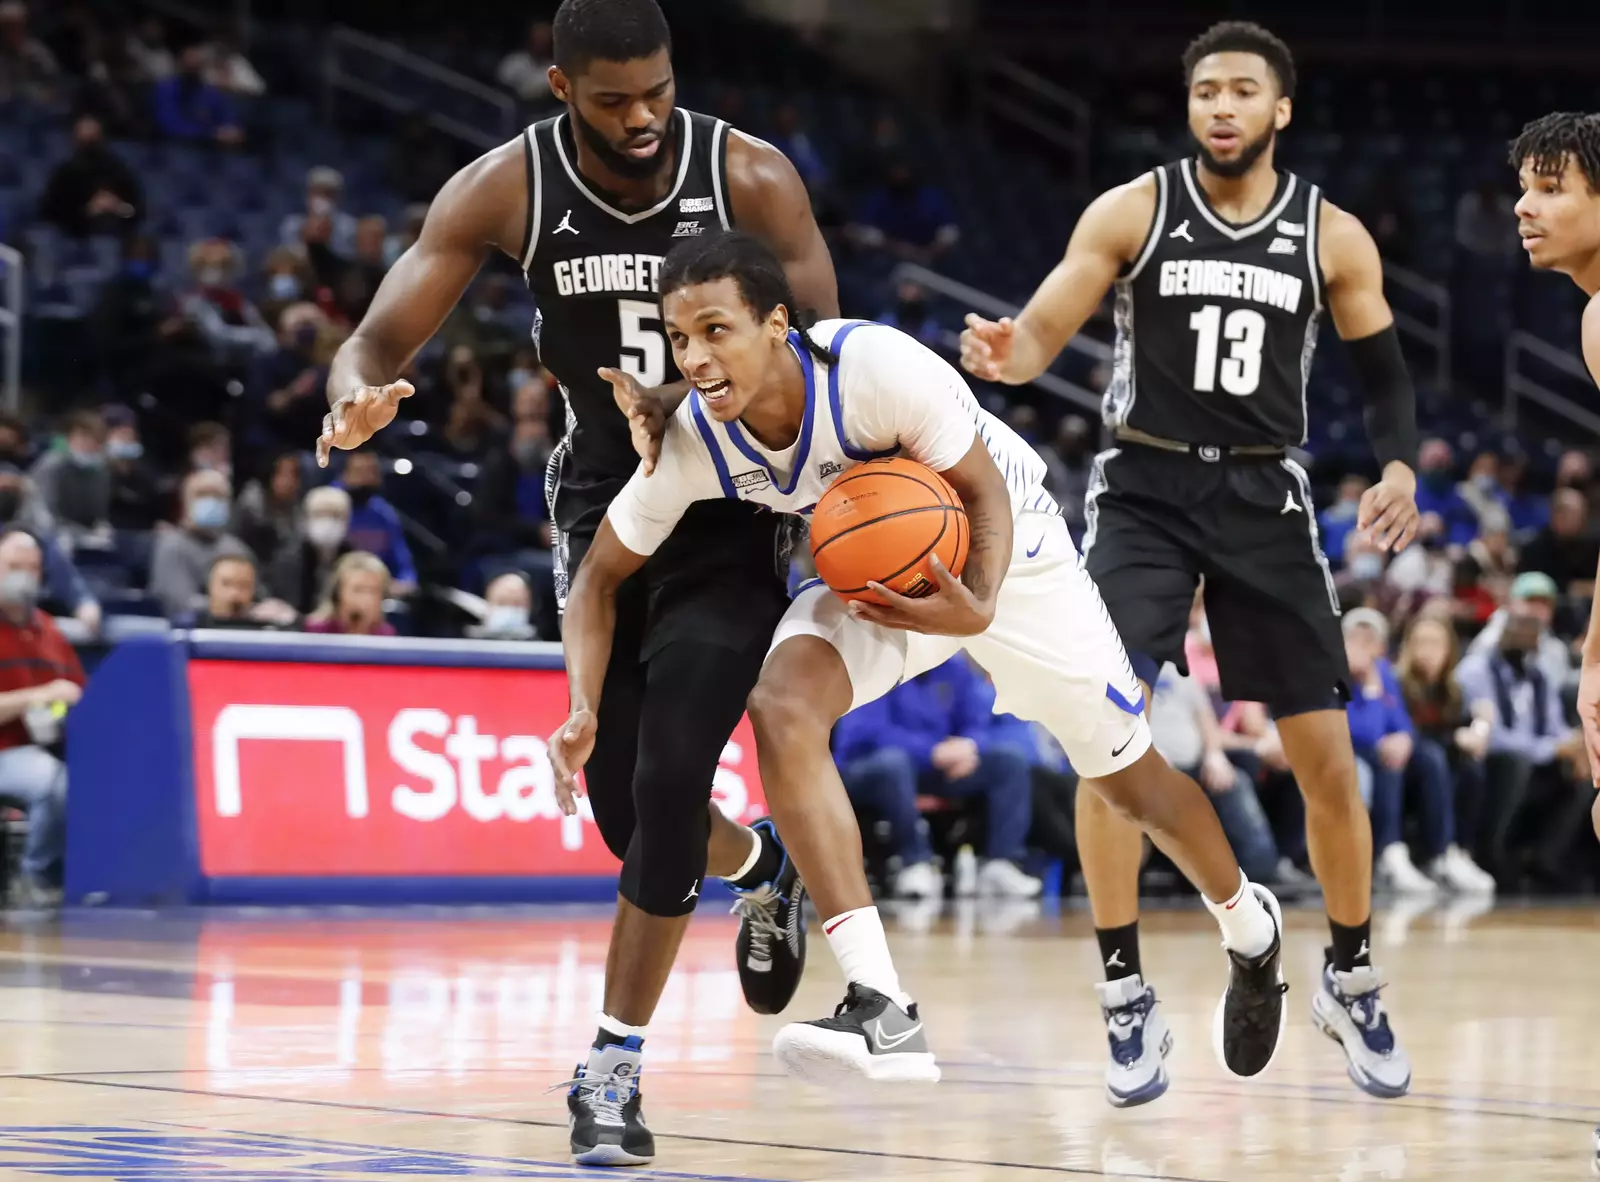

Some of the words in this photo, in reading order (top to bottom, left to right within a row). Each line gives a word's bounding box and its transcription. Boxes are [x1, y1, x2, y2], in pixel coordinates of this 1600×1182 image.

[674, 227, 705, 235] EAST
[680, 205, 714, 213] CHANGE
[553, 254, 664, 296] GEORGET
[1159, 260, 1302, 314] GEORGETOWN
[618, 299, 666, 388] 5
[1189, 304, 1266, 396] 13
[388, 708, 748, 850] Stas
